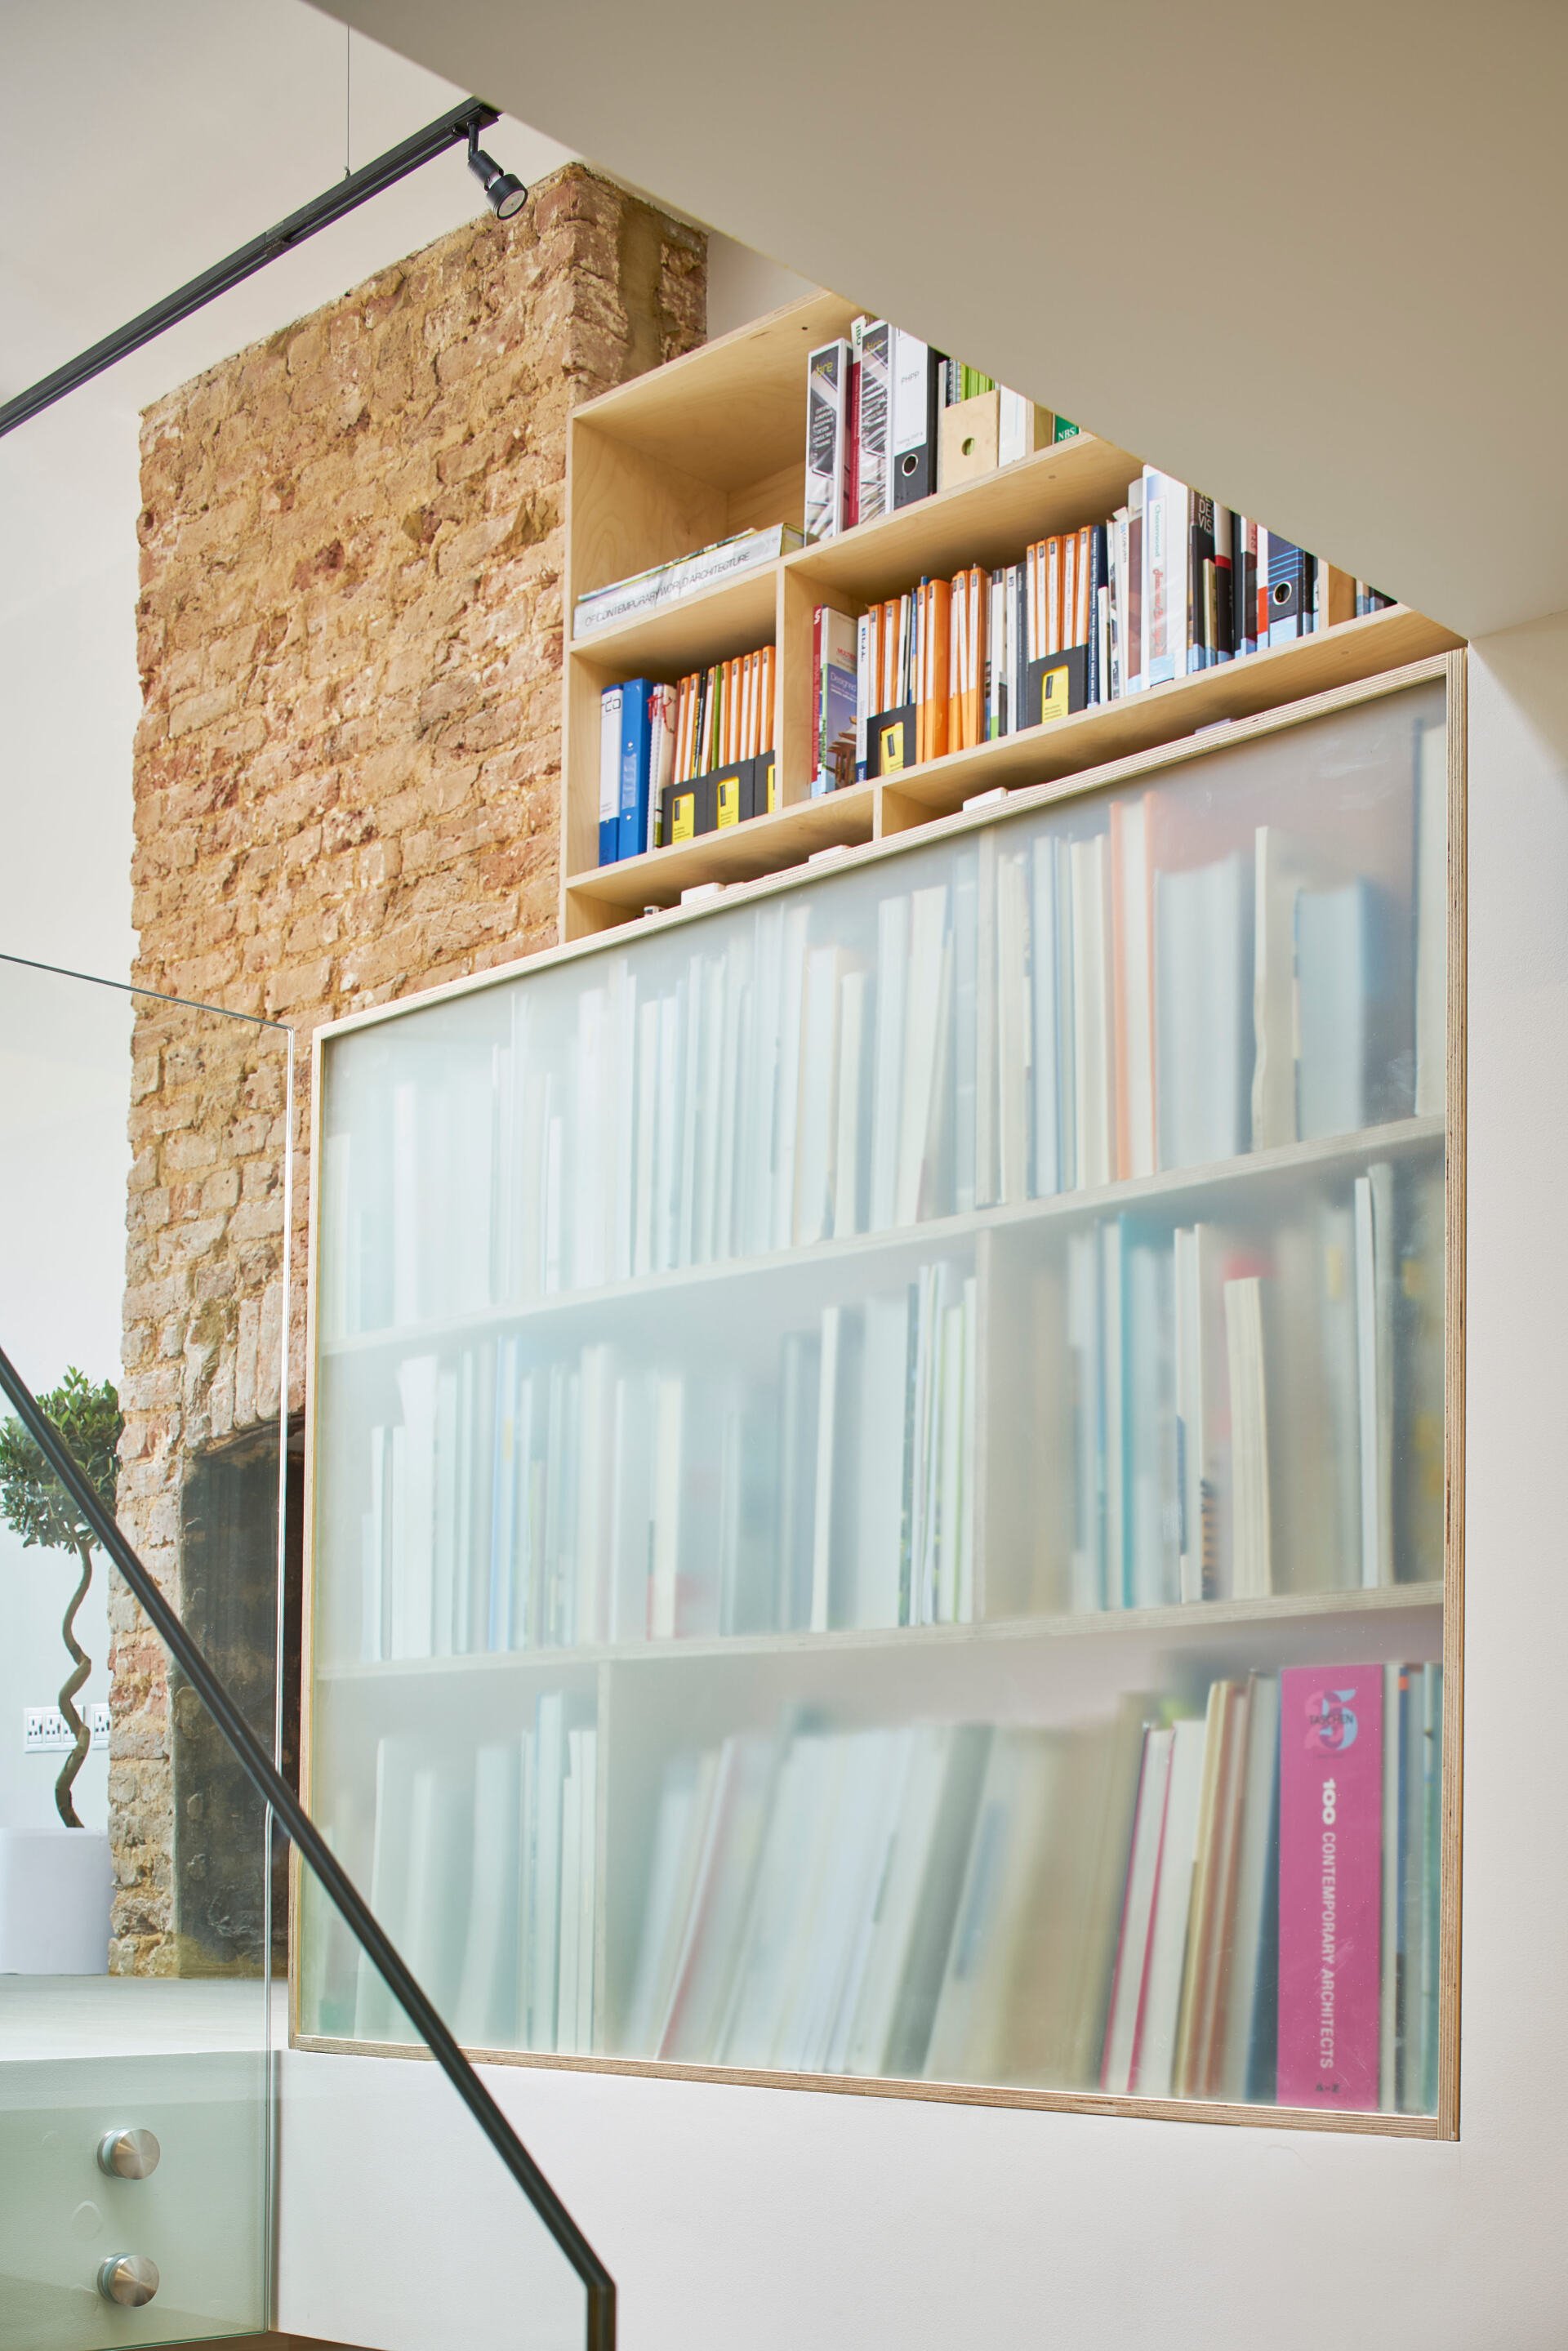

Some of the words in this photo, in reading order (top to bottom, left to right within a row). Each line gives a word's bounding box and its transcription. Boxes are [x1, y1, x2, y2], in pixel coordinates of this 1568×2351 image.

[1058, 427, 1076, 442] NBS
[1199, 498, 1214, 520] DE
[597, 589, 660, 621] CONTEMPORARY
[688, 551, 751, 582] ARCHITECTURE
[1310, 1715, 1354, 1725] TASCHEN
[1321, 1777, 1336, 1825] 100
[1321, 1832, 1336, 1965] CONTEMPORARY
[1320, 1968, 1335, 2069] ARCHITECTS
[1315, 2083, 1340, 2094] A-Z
